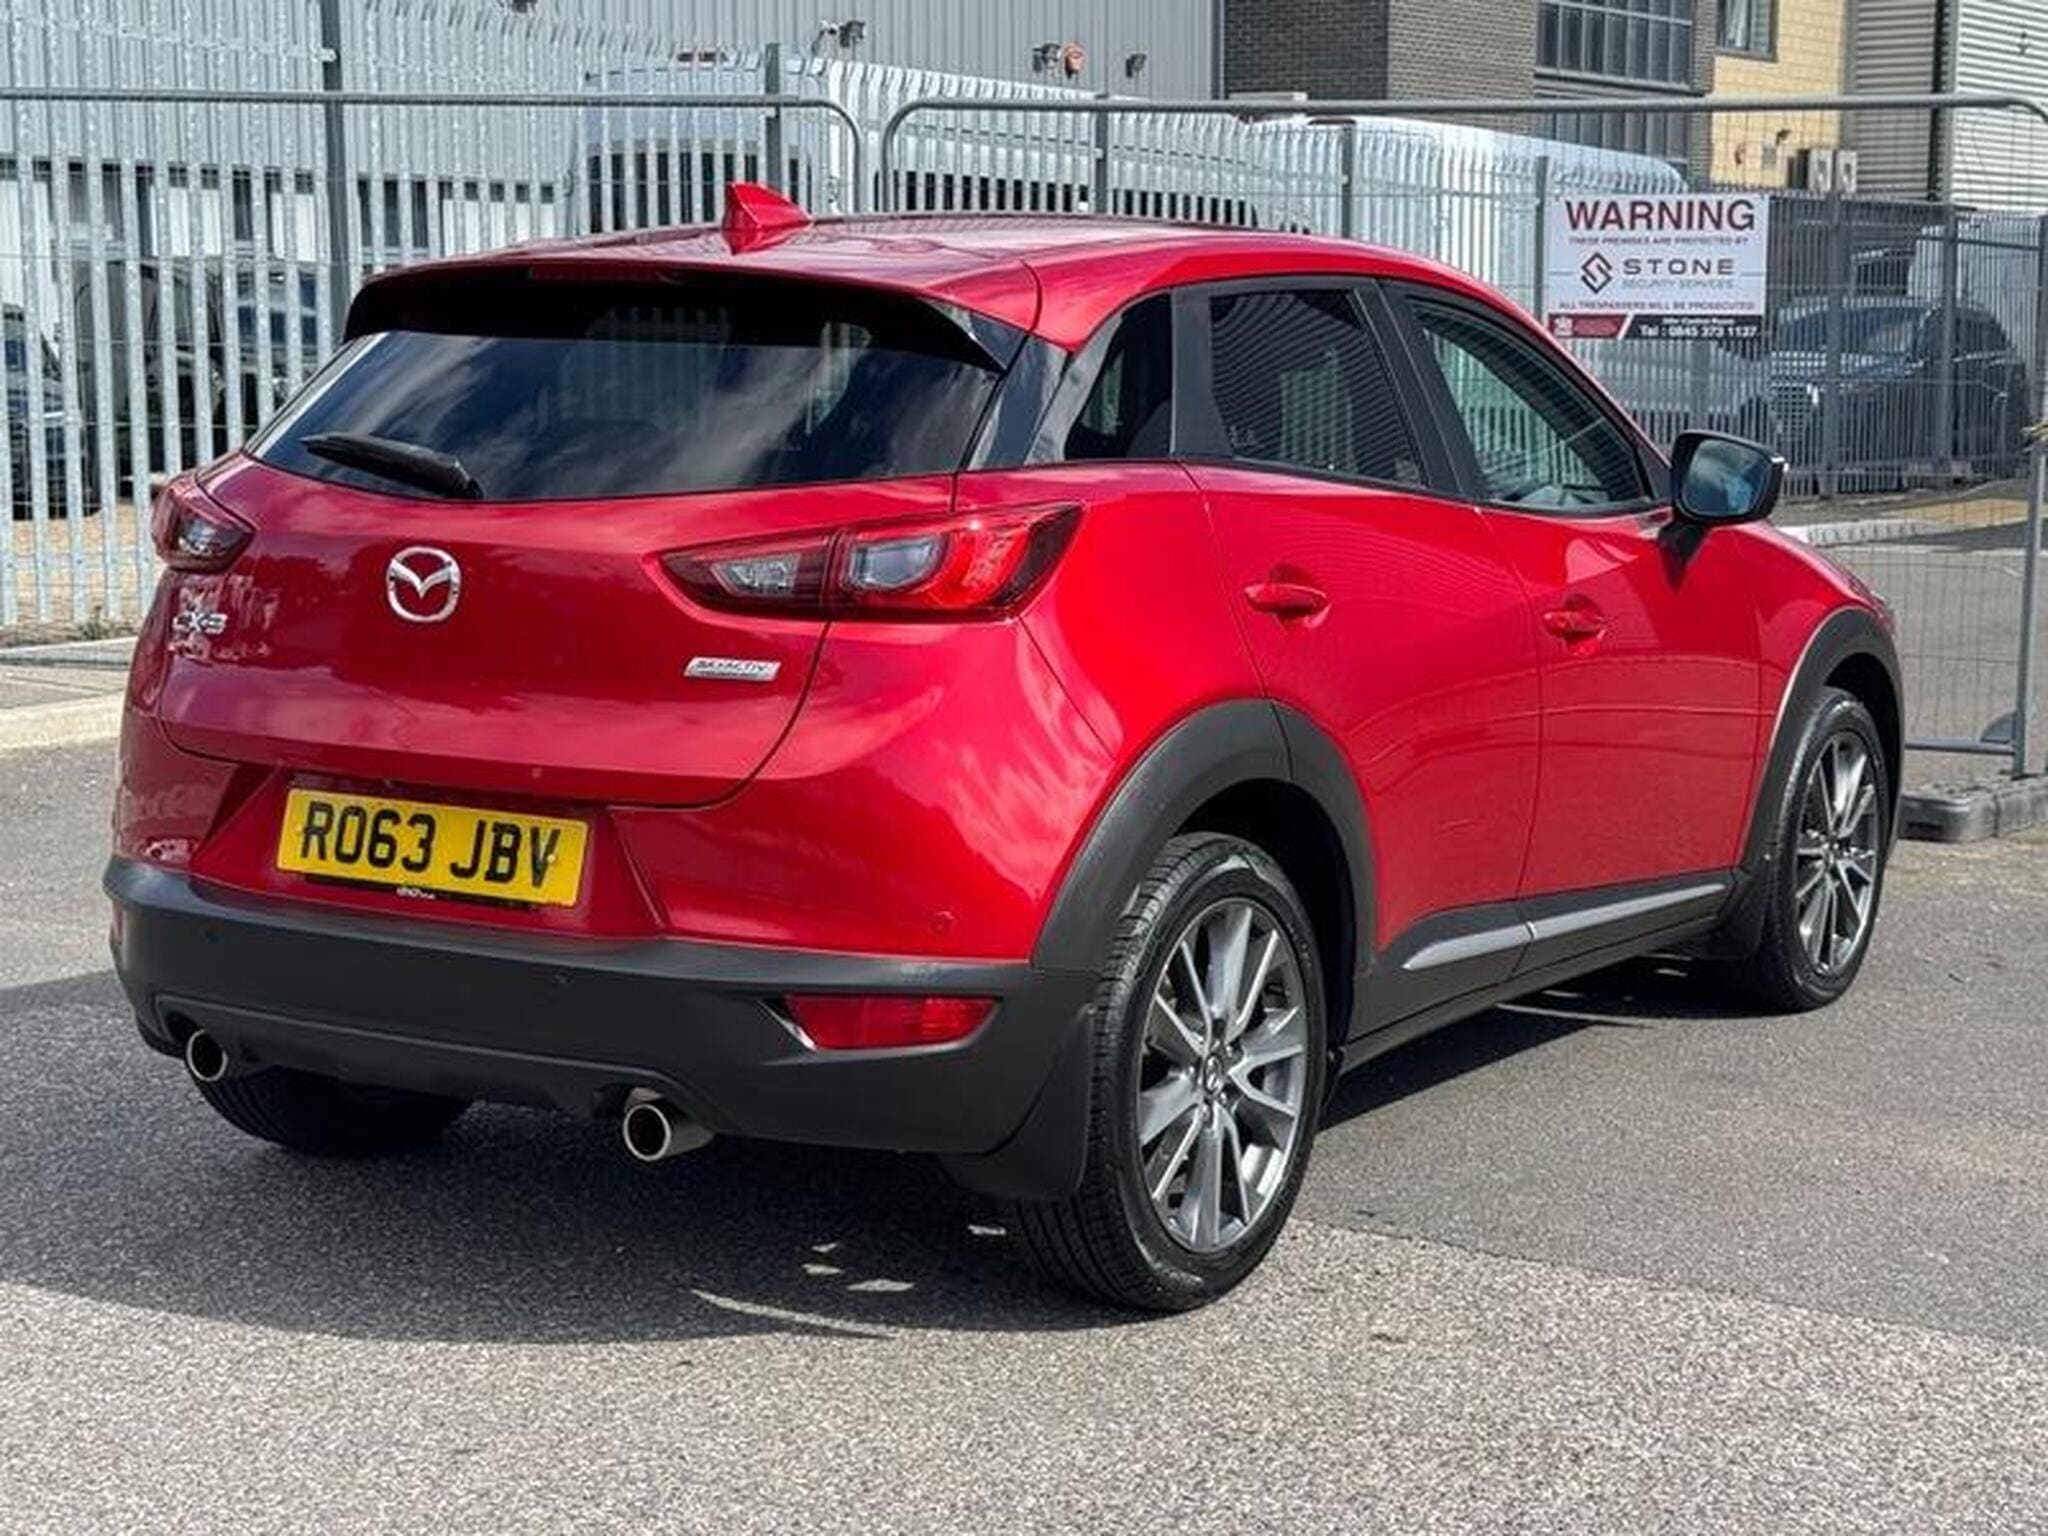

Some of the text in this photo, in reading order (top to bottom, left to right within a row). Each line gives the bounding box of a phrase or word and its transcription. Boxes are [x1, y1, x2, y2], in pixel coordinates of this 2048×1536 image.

[1566, 200, 1755, 231] WARNING
[1623, 258, 1734, 275] STONE
[1622, 279, 1734, 290] SECURITY SERVICES
[1639, 325, 1659, 337] Tel
[301, 800, 561, 889] RO63 JBV
